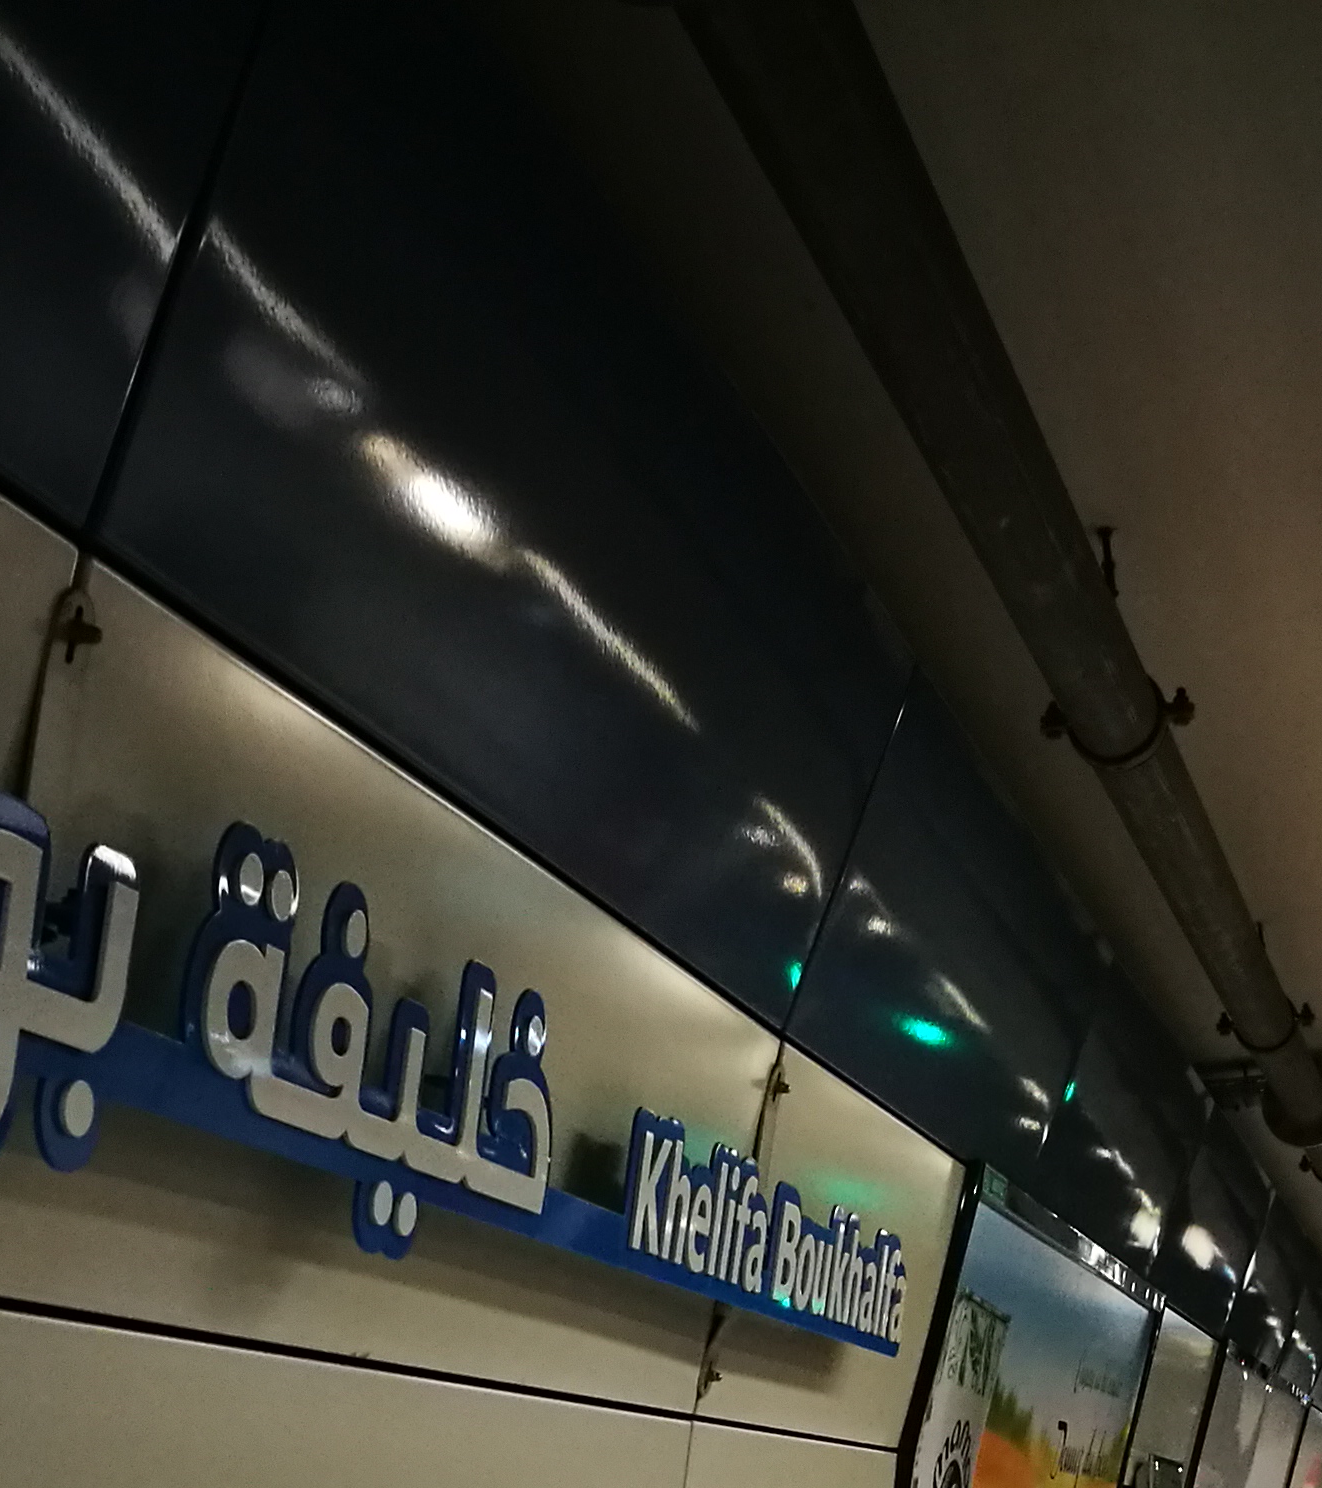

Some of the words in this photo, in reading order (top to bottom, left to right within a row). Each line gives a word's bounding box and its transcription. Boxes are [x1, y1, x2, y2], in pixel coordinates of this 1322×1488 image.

[200, 850, 553, 1238] خليفة
[628, 1130, 768, 1294] Khelifa
[772, 1201, 907, 1344] Boukhalfa
